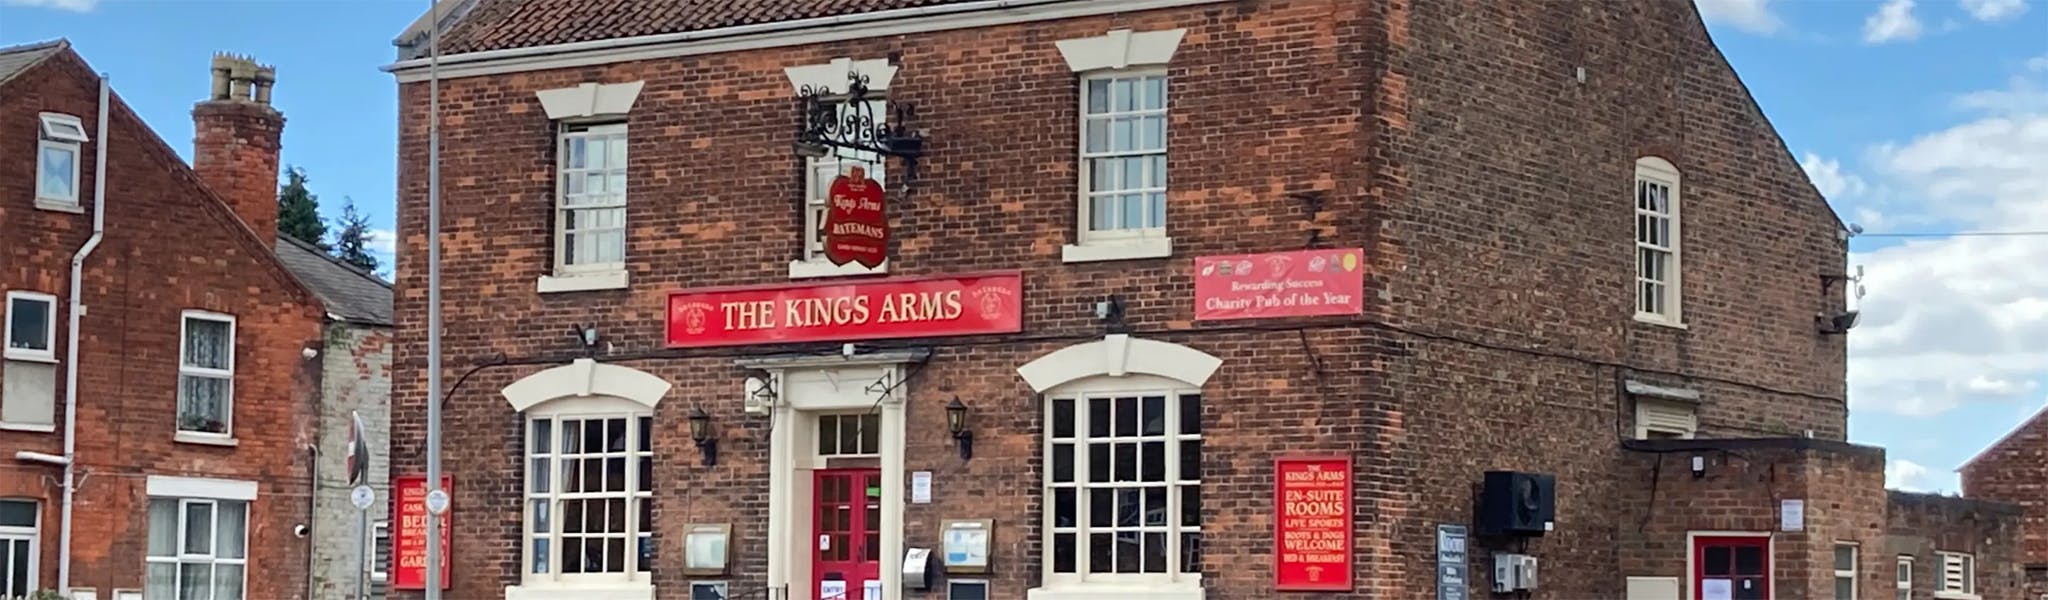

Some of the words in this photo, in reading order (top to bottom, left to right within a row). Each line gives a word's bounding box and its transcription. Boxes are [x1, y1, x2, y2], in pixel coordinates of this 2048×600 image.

[833, 223, 884, 239] BATEMANS
[1231, 280, 1284, 293] Rewarding
[1286, 278, 1324, 290] Success
[1206, 297, 1252, 312] Charity
[1256, 295, 1281, 309] Pub
[1283, 293, 1297, 306] of
[1300, 293, 1319, 305] the
[1323, 291, 1351, 305] Year
[721, 300, 776, 331] THE
[785, 294, 870, 328] KINGS
[877, 289, 963, 323] ARMS
[1285, 471, 1315, 481] KINGS
[1316, 470, 1345, 481] ARMS
[1285, 489, 1345, 502] EN-SUITE
[1285, 501, 1345, 516] ROOMS
[1285, 518, 1307, 528] LIVE
[1284, 539, 1345, 551] WELCOME
